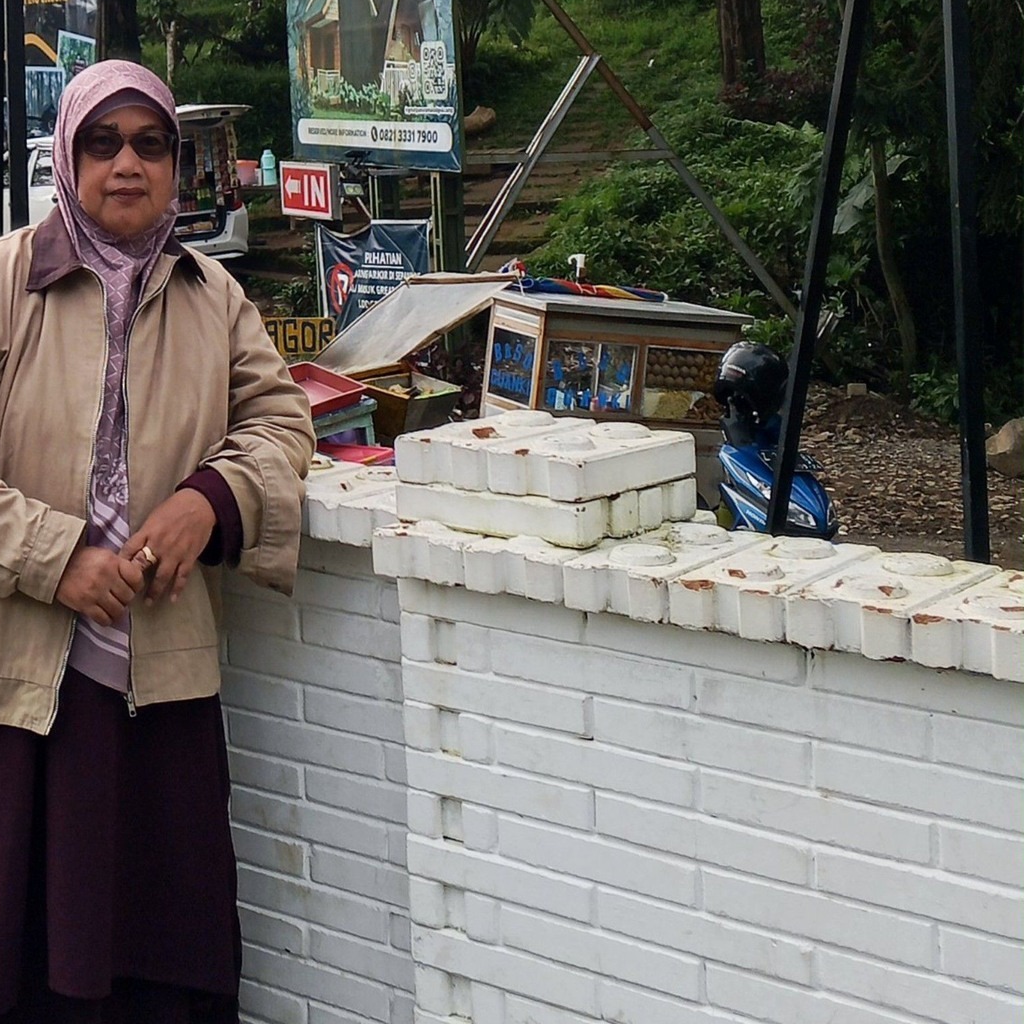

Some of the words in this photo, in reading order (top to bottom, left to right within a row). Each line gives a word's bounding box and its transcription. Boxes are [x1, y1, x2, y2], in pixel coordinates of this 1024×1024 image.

[380, 128, 396, 142] 0821
[398, 129, 415, 143] 3331
[417, 130, 438, 143] 7900
[303, 174, 326, 208] IN
